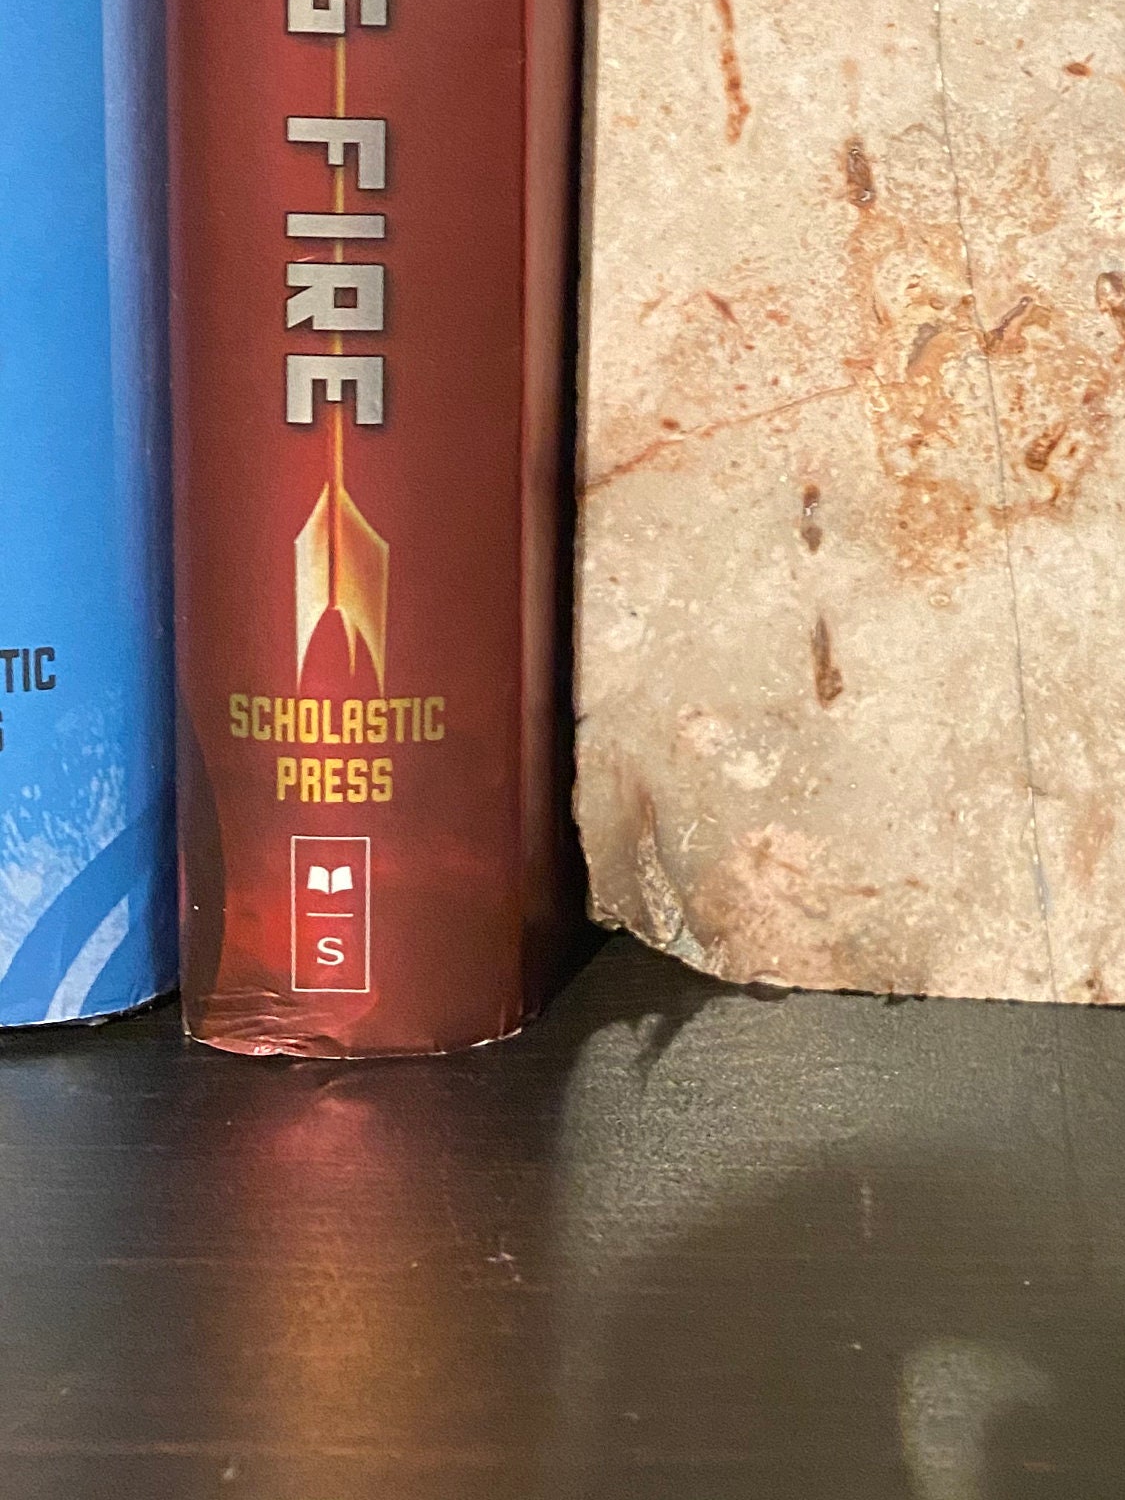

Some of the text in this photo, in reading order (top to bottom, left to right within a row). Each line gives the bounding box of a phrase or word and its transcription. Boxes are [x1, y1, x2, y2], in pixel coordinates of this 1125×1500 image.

[285, 116, 387, 426] FIRE
[229, 694, 445, 744] SCHOLASTIC
[276, 756, 394, 804] PRESS
[316, 936, 345, 966] S
